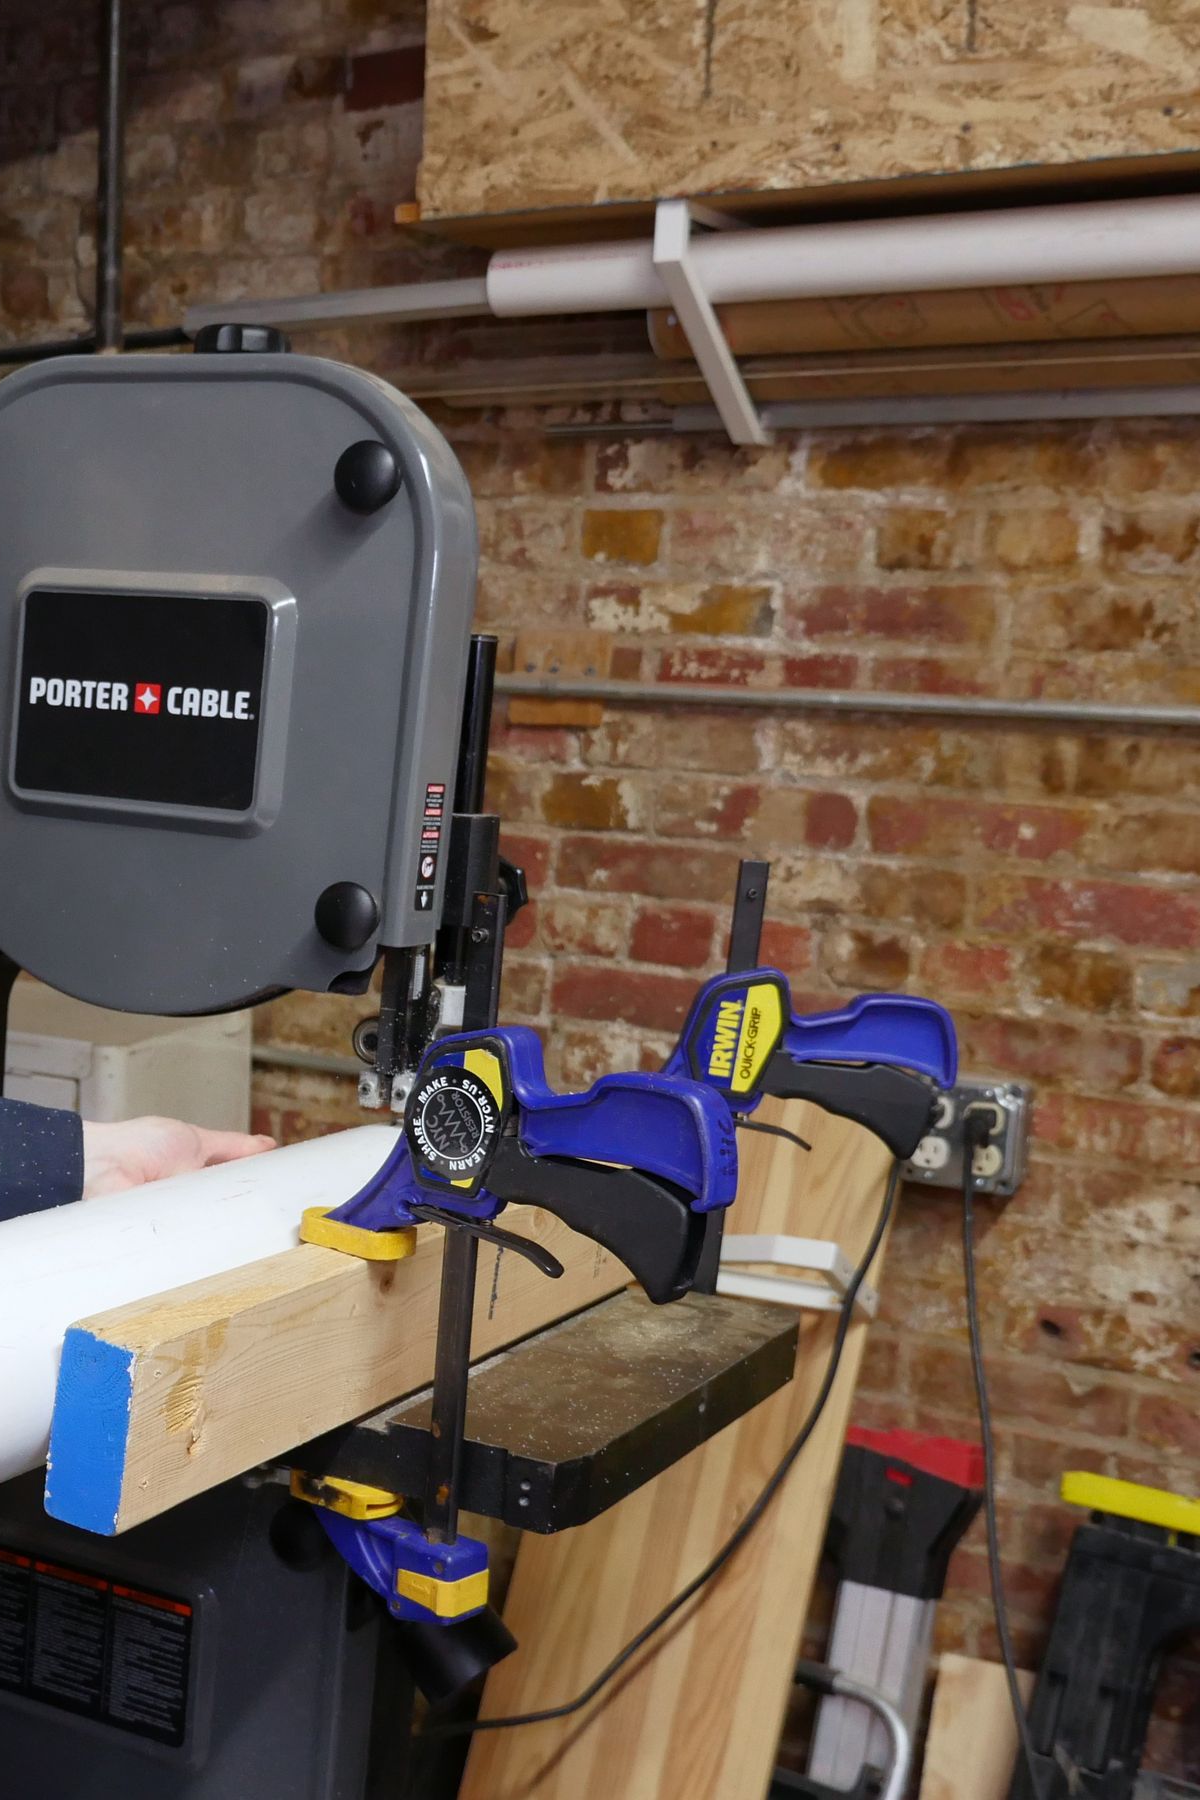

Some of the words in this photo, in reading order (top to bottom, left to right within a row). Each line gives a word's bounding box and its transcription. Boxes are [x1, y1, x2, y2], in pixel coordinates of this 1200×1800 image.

[29, 677, 128, 711] PORTER
[167, 687, 251, 720] CABLE
[708, 1000, 742, 1077] IRWIN
[739, 1007, 761, 1079] QUICK-GRIP
[417, 1076, 448, 1104] MAKE
[461, 1079, 495, 1134] NYCR.US
[425, 1115, 450, 1151] NYC
[451, 1090, 480, 1139] RESISTOR
[413, 1118, 437, 1161] SHARE
[449, 1147, 487, 1171] LEARN
